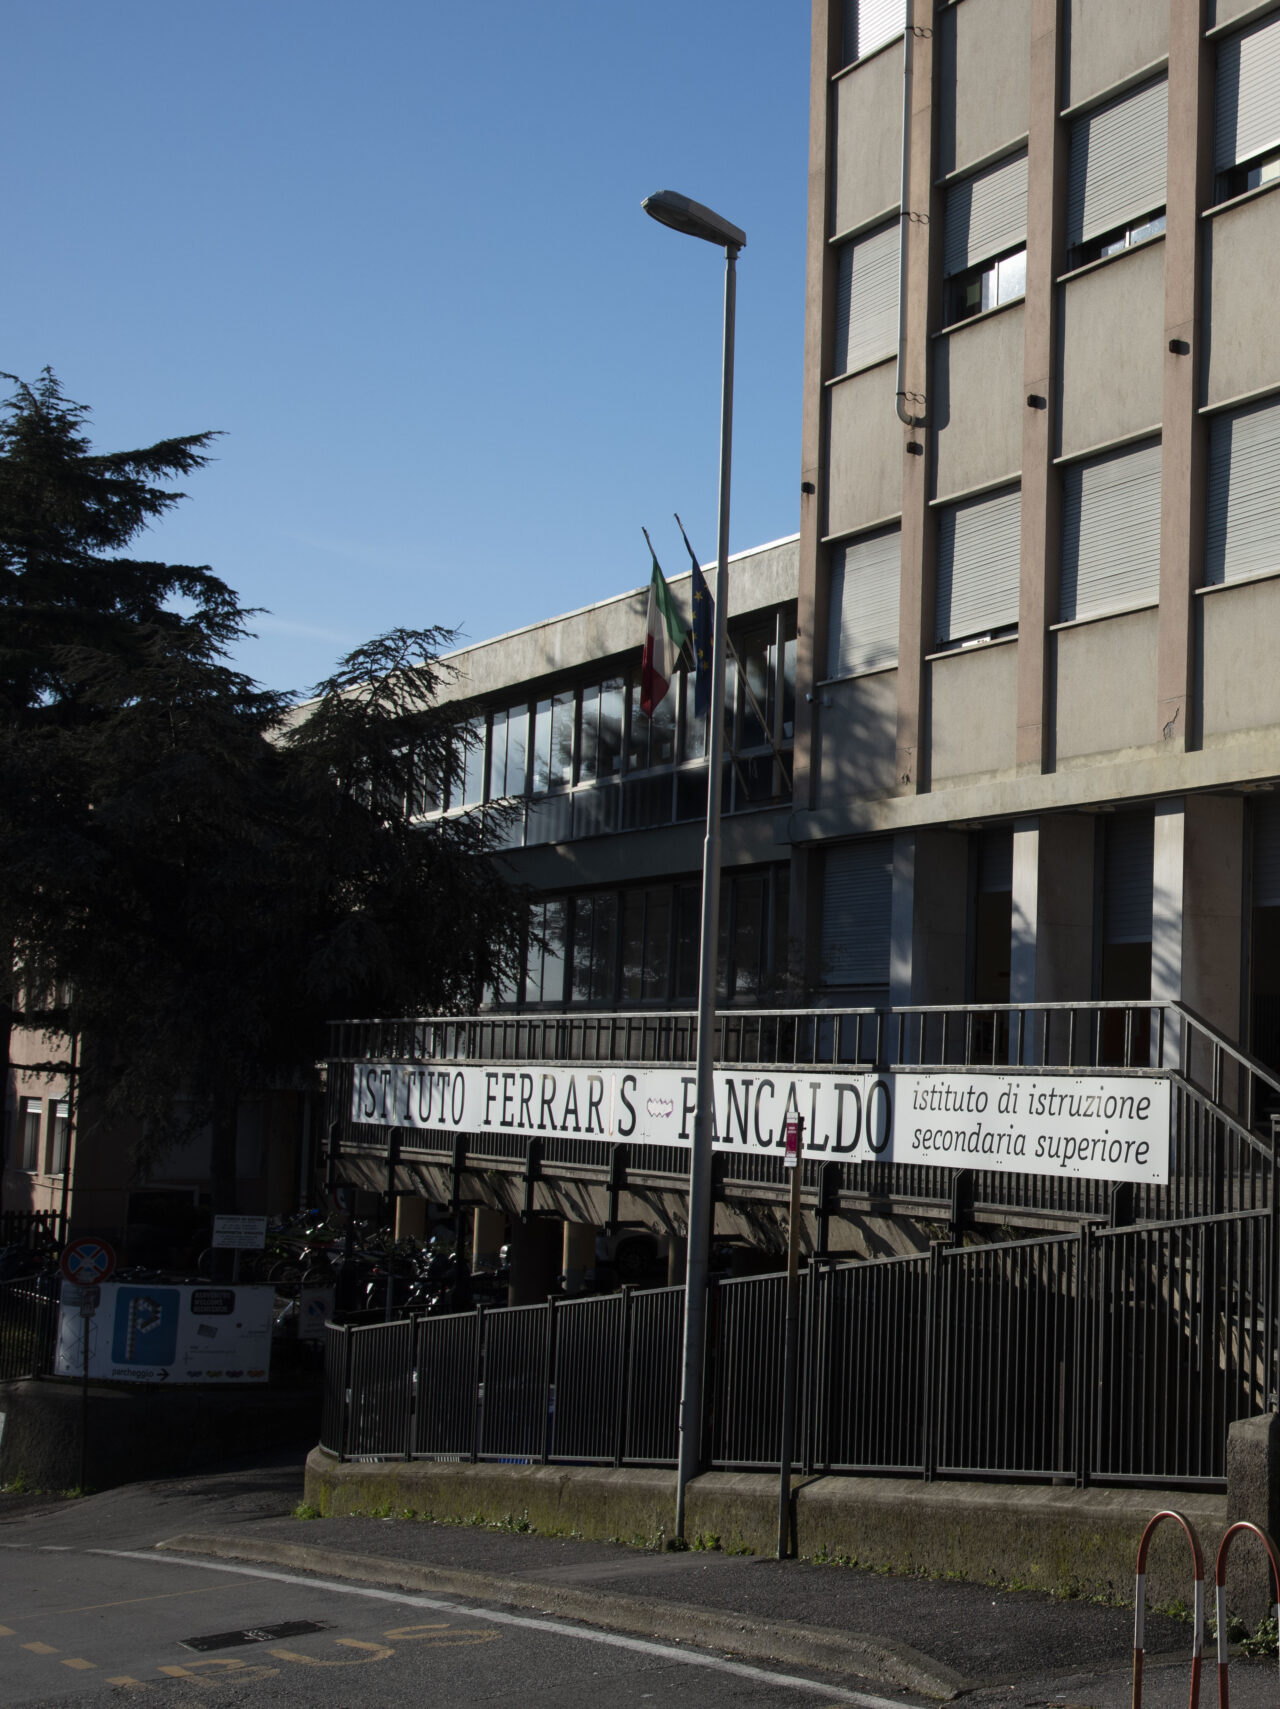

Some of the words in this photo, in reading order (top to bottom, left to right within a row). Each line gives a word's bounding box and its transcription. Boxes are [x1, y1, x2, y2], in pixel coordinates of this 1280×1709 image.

[358, 1068, 466, 1125] ISTITUTO
[483, 1072, 637, 1137] FERRARIS
[678, 1077, 892, 1154] PNCALDO
[912, 1080, 988, 1113] istituto
[997, 1083, 1021, 1115] di
[1028, 1083, 1151, 1121] istruzione
[911, 1123, 1027, 1156] secondaria
[1034, 1129, 1150, 1168] superiore
[111, 1367, 154, 1379] parcheggio
[158, 1623, 502, 1687] BUS
